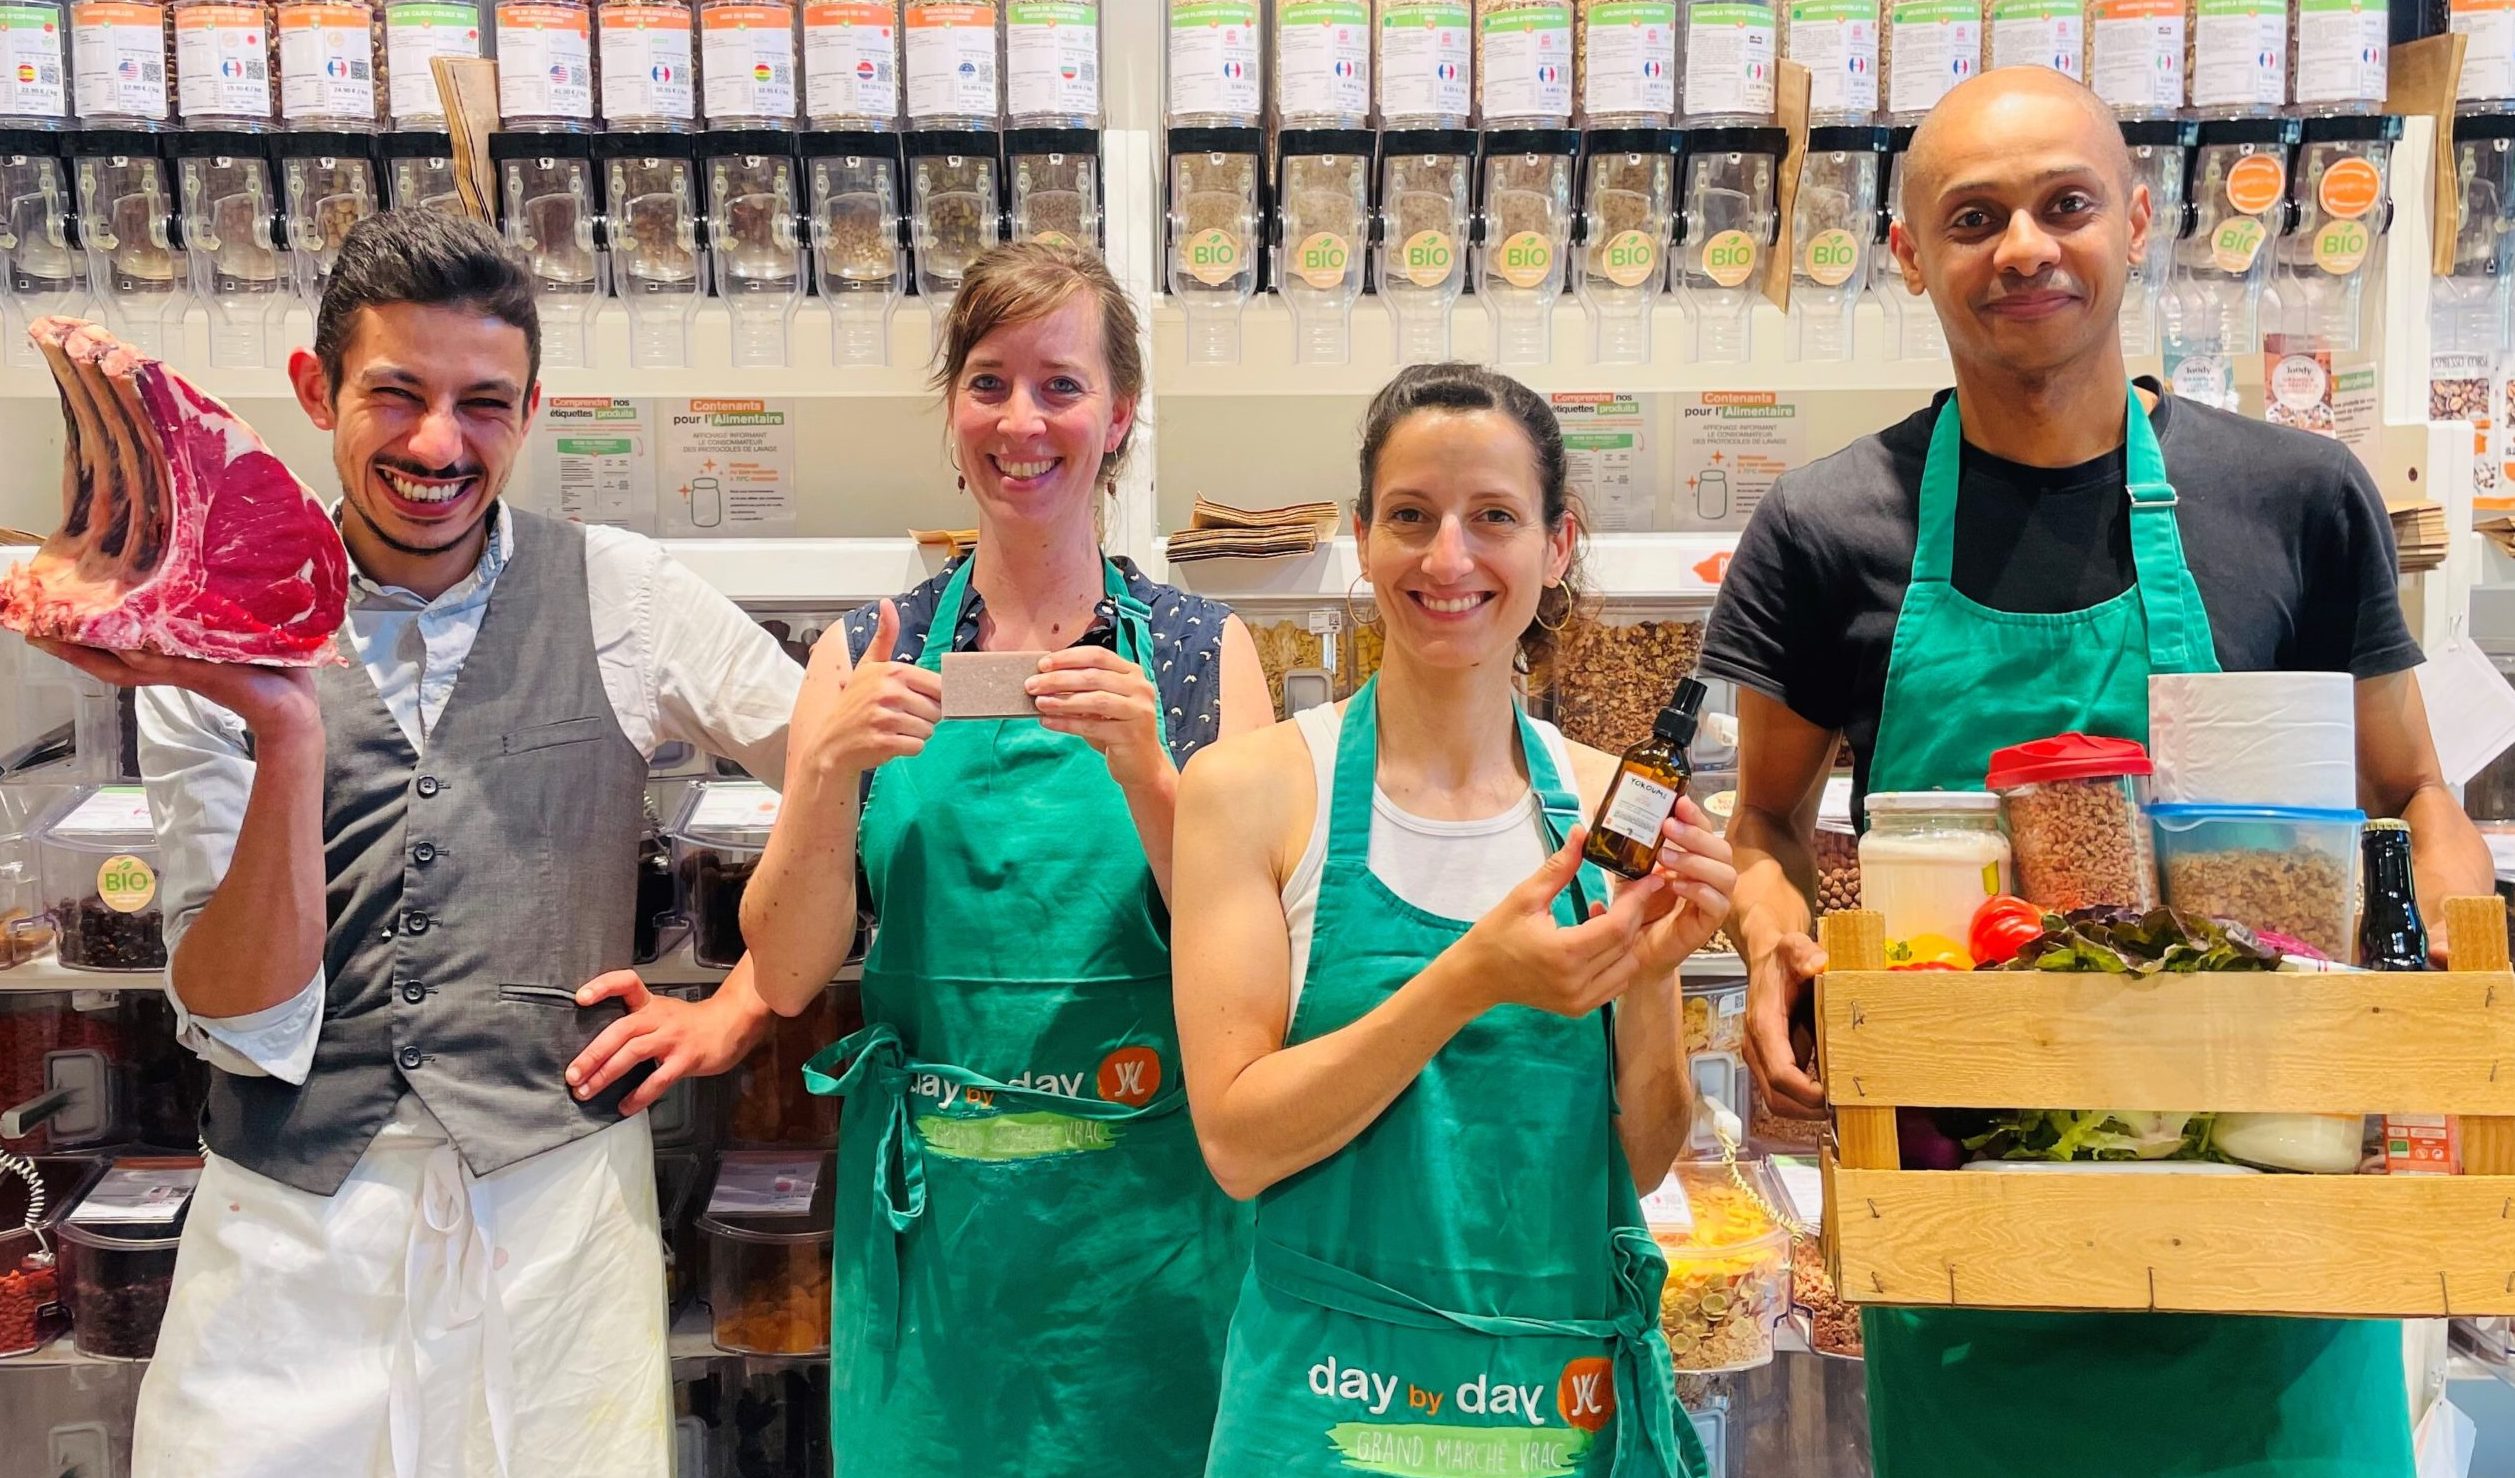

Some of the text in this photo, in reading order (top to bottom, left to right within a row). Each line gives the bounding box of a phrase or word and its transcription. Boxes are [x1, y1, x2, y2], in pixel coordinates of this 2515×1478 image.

[2323, 235, 2363, 253] BIO
[1195, 246, 1234, 265] BIO
[1305, 250, 1344, 268] BIO
[1409, 247, 1449, 267] BIO
[1507, 248, 1547, 266] BIO
[1611, 246, 1650, 266] BIO
[1711, 247, 1750, 266] BIO
[1813, 246, 1853, 265] BIO
[553, 398, 630, 408] Comprendre nos
[693, 400, 761, 411] Contenants
[1555, 393, 1612, 403] Comprendre
[1704, 392, 1772, 403] Contenants
[550, 409, 635, 419] étiquettes produits
[1600, 404, 1637, 414] produits
[1685, 407, 1712, 418] pour
[1725, 406, 1793, 417] Alimentaire
[673, 415, 701, 426] pour
[714, 413, 782, 424] Alimentaire
[105, 872, 148, 892] BIO
[966, 1087, 995, 1107] by
[1309, 1356, 1545, 1425] day by day
[1356, 1431, 1424, 1467] GRAND
[1519, 1442, 1562, 1471] VRAC
